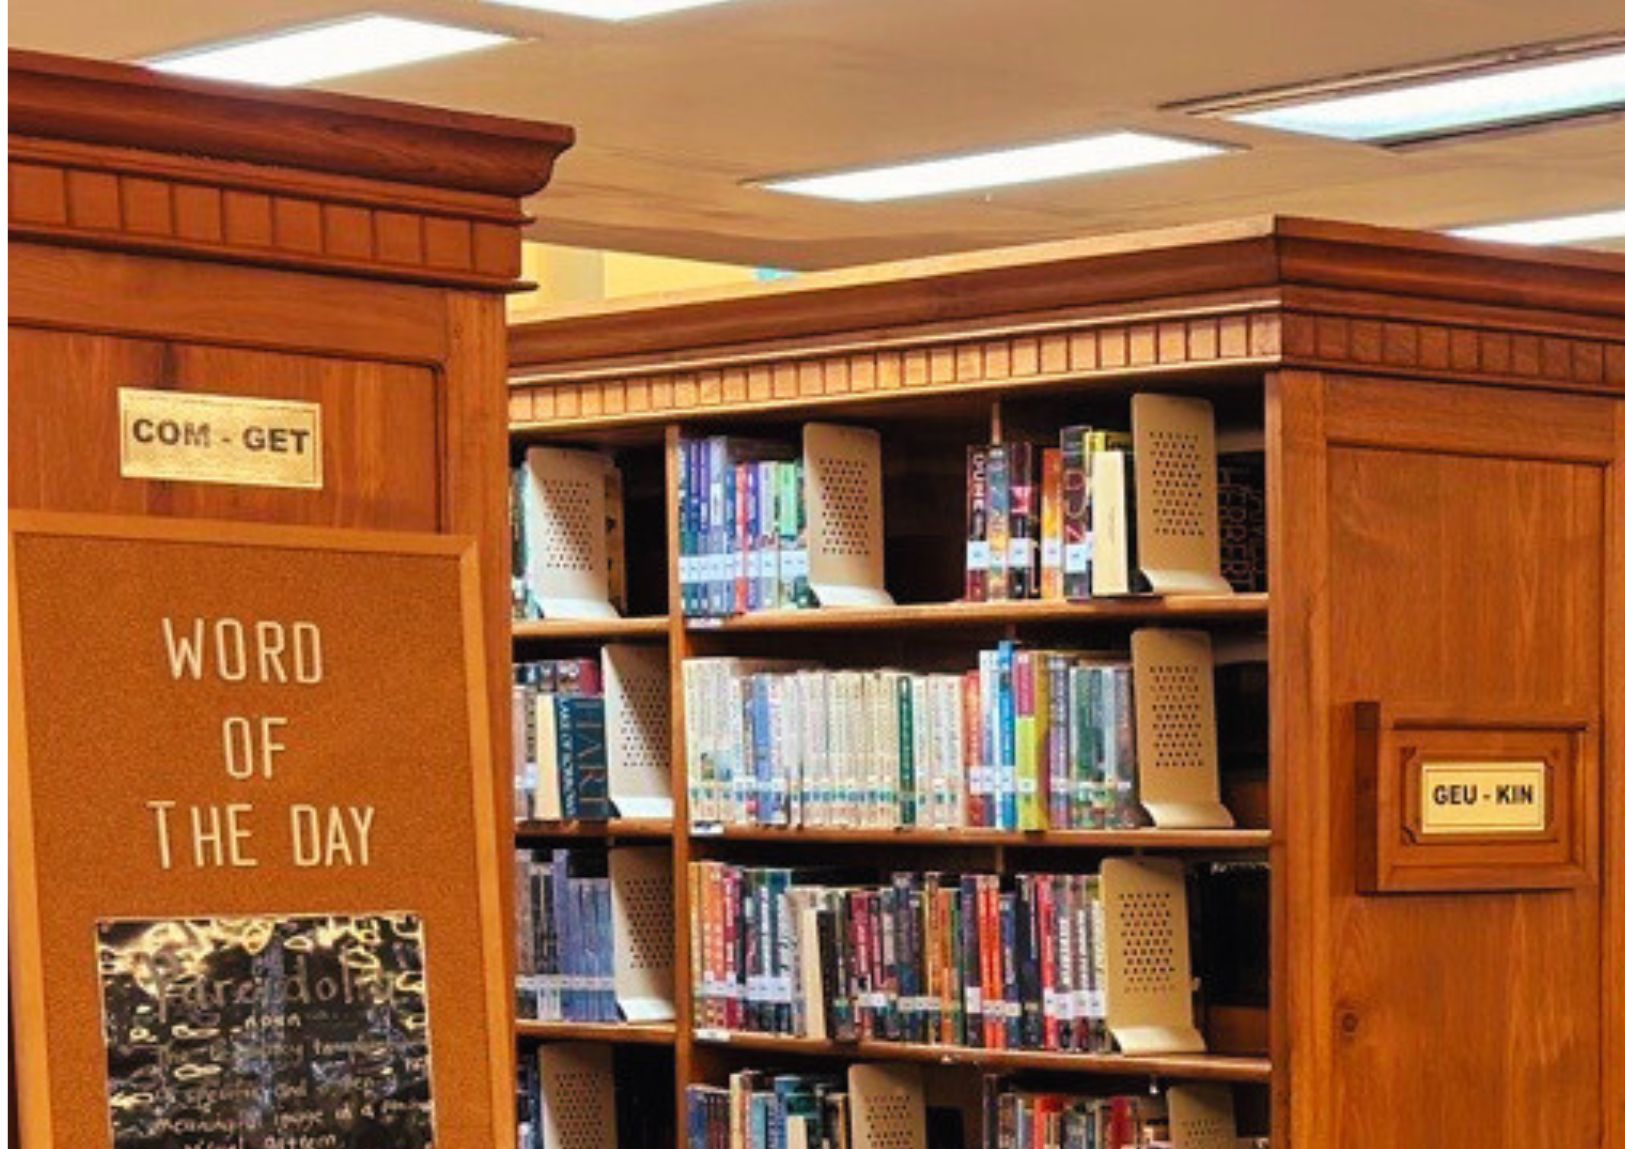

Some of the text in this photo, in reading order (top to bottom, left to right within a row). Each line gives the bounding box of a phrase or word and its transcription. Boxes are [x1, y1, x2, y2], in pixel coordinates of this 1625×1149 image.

[132, 417, 211, 448] COM
[242, 426, 310, 455] GET
[161, 617, 324, 685] WORD
[222, 716, 288, 780] OF
[1433, 784, 1479, 805] GEU
[1496, 784, 1533, 805] KIN
[146, 800, 375, 870] THE DAY
